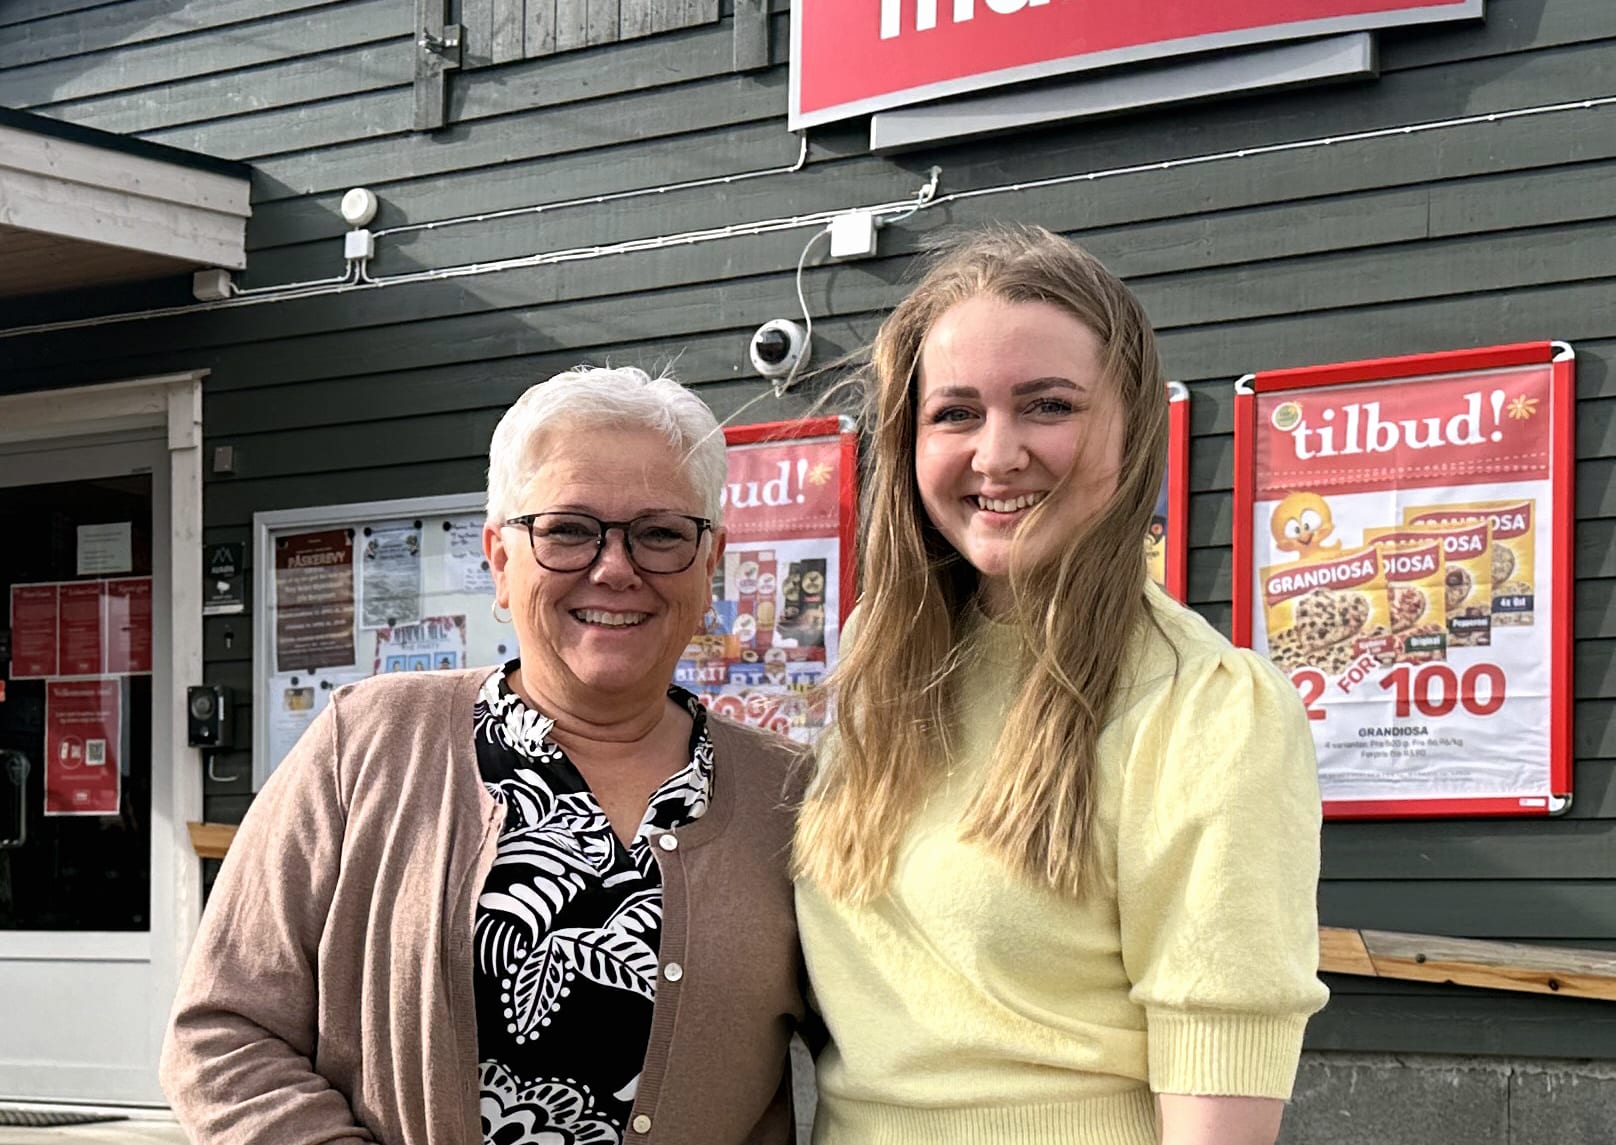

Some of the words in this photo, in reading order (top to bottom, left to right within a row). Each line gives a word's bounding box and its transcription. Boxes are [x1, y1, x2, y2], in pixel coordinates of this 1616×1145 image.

[1291, 389, 1506, 460] tilbud!
[719, 458, 808, 508] ud!
[1268, 559, 1375, 595] GRANDIOSA
[675, 666, 726, 682] BIXIT
[1291, 669, 1327, 719] 2
[1337, 656, 1377, 694] FOR
[1379, 663, 1507, 718] 100
[1358, 726, 1429, 737] GRANDIOSA
